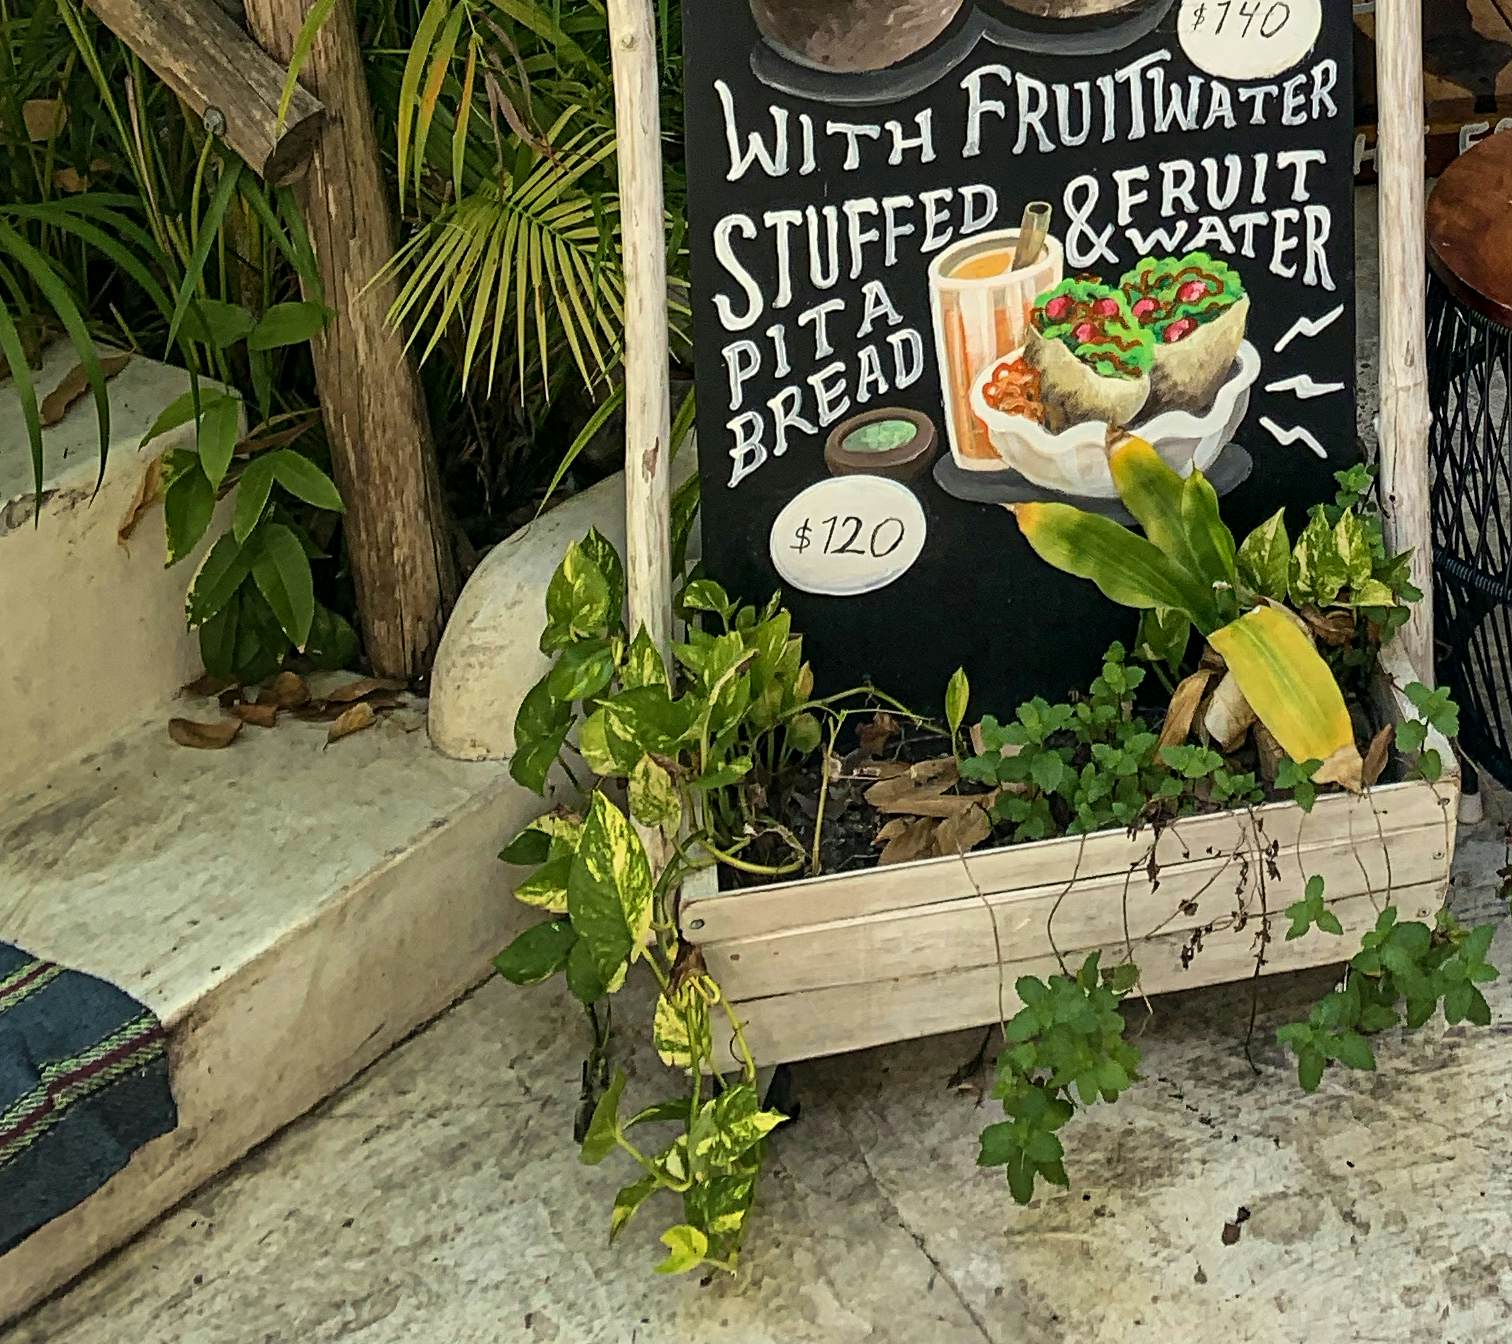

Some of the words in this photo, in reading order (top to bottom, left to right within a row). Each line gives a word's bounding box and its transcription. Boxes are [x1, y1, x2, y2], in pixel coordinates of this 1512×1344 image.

[714, 78, 937, 182] WITH
[712, 183, 999, 332] STUFFED
[1063, 174, 1121, 269] &
[1113, 149, 1328, 226] FRUIT
[1125, 204, 1336, 292] WATER
[721, 280, 904, 412] PITA
[726, 328, 925, 489] BREAD
[787, 514, 907, 560] $120
